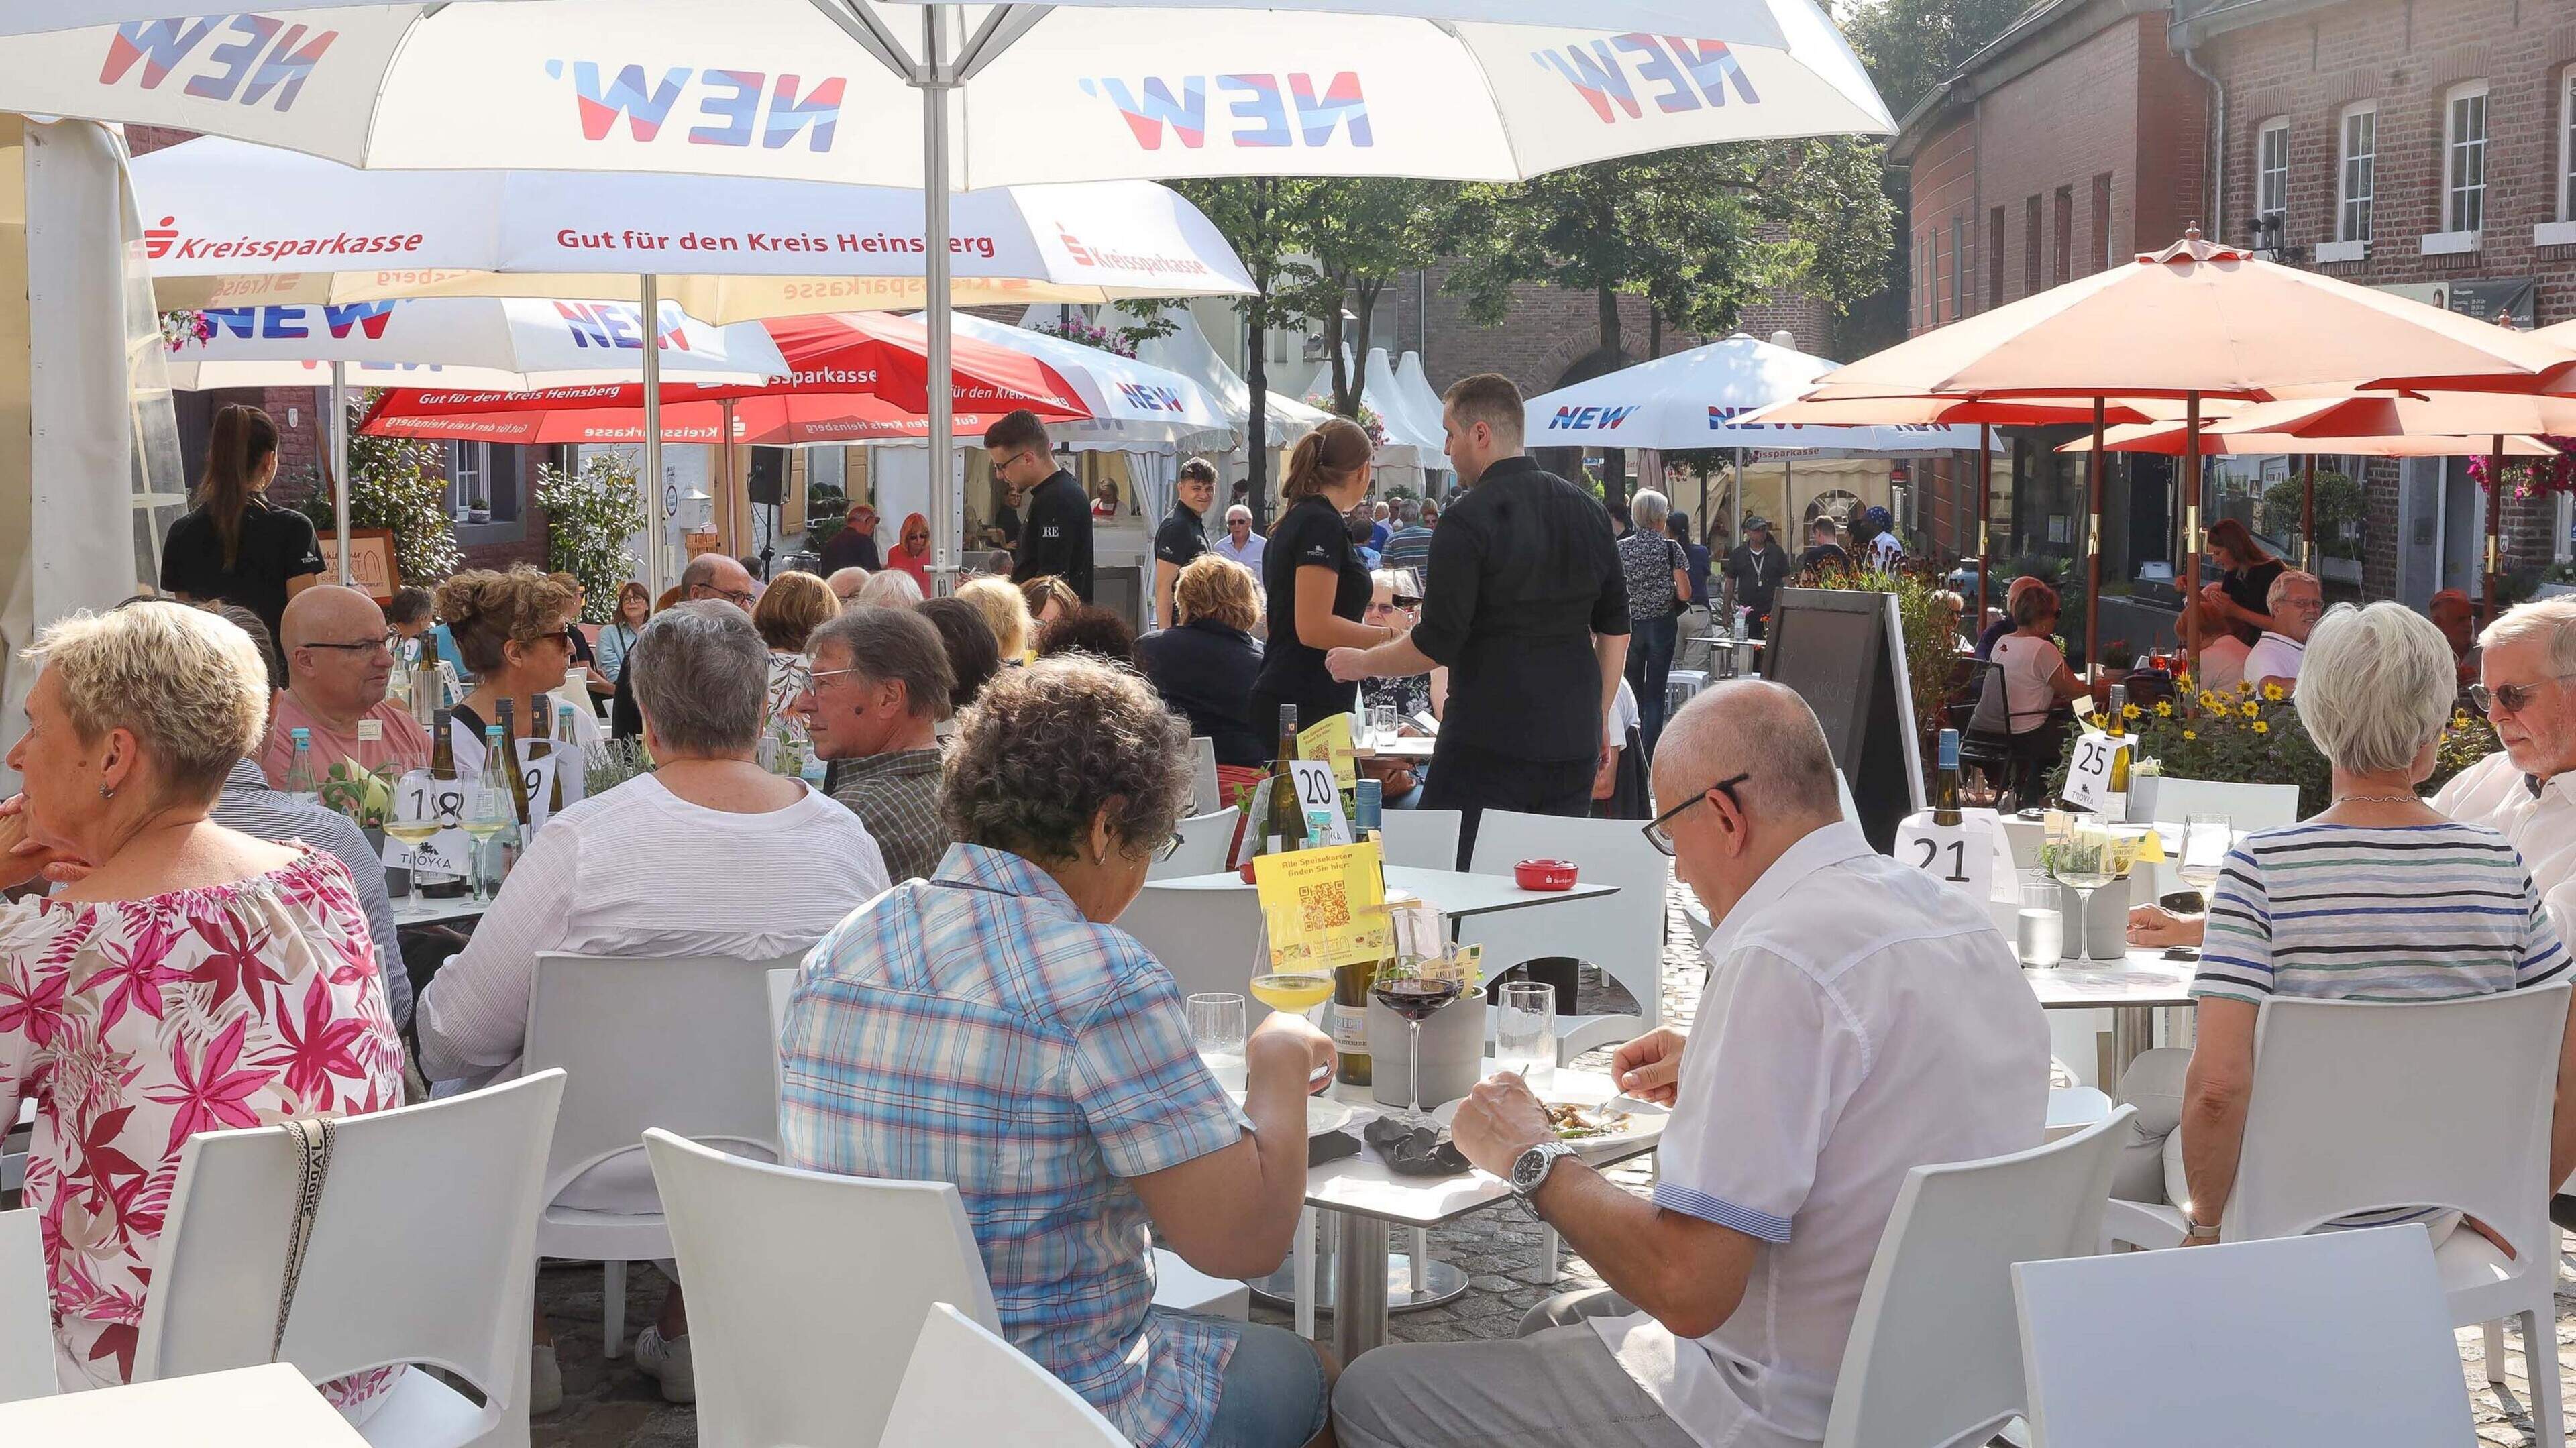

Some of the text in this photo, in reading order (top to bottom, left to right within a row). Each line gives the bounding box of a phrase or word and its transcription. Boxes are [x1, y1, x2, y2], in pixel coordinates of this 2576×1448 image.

[176, 232, 423, 261] Kreissparkasse
[557, 229, 994, 258] Gut für den Kreis Heinserg
[1090, 247, 1208, 277] Kreissparkasse
[419, 386, 621, 405] Gut für den Kreis Heinsberg
[969, 385, 993, 399] den
[445, 665, 456, 683] 30
[2079, 742, 2106, 775] 25
[1299, 769, 1331, 805] 20
[411, 788, 464, 830] 18
[1282, 852, 1353, 869] Alle Speisekarten
[1288, 869, 1314, 877] finden
[1914, 838, 1970, 882] 21
